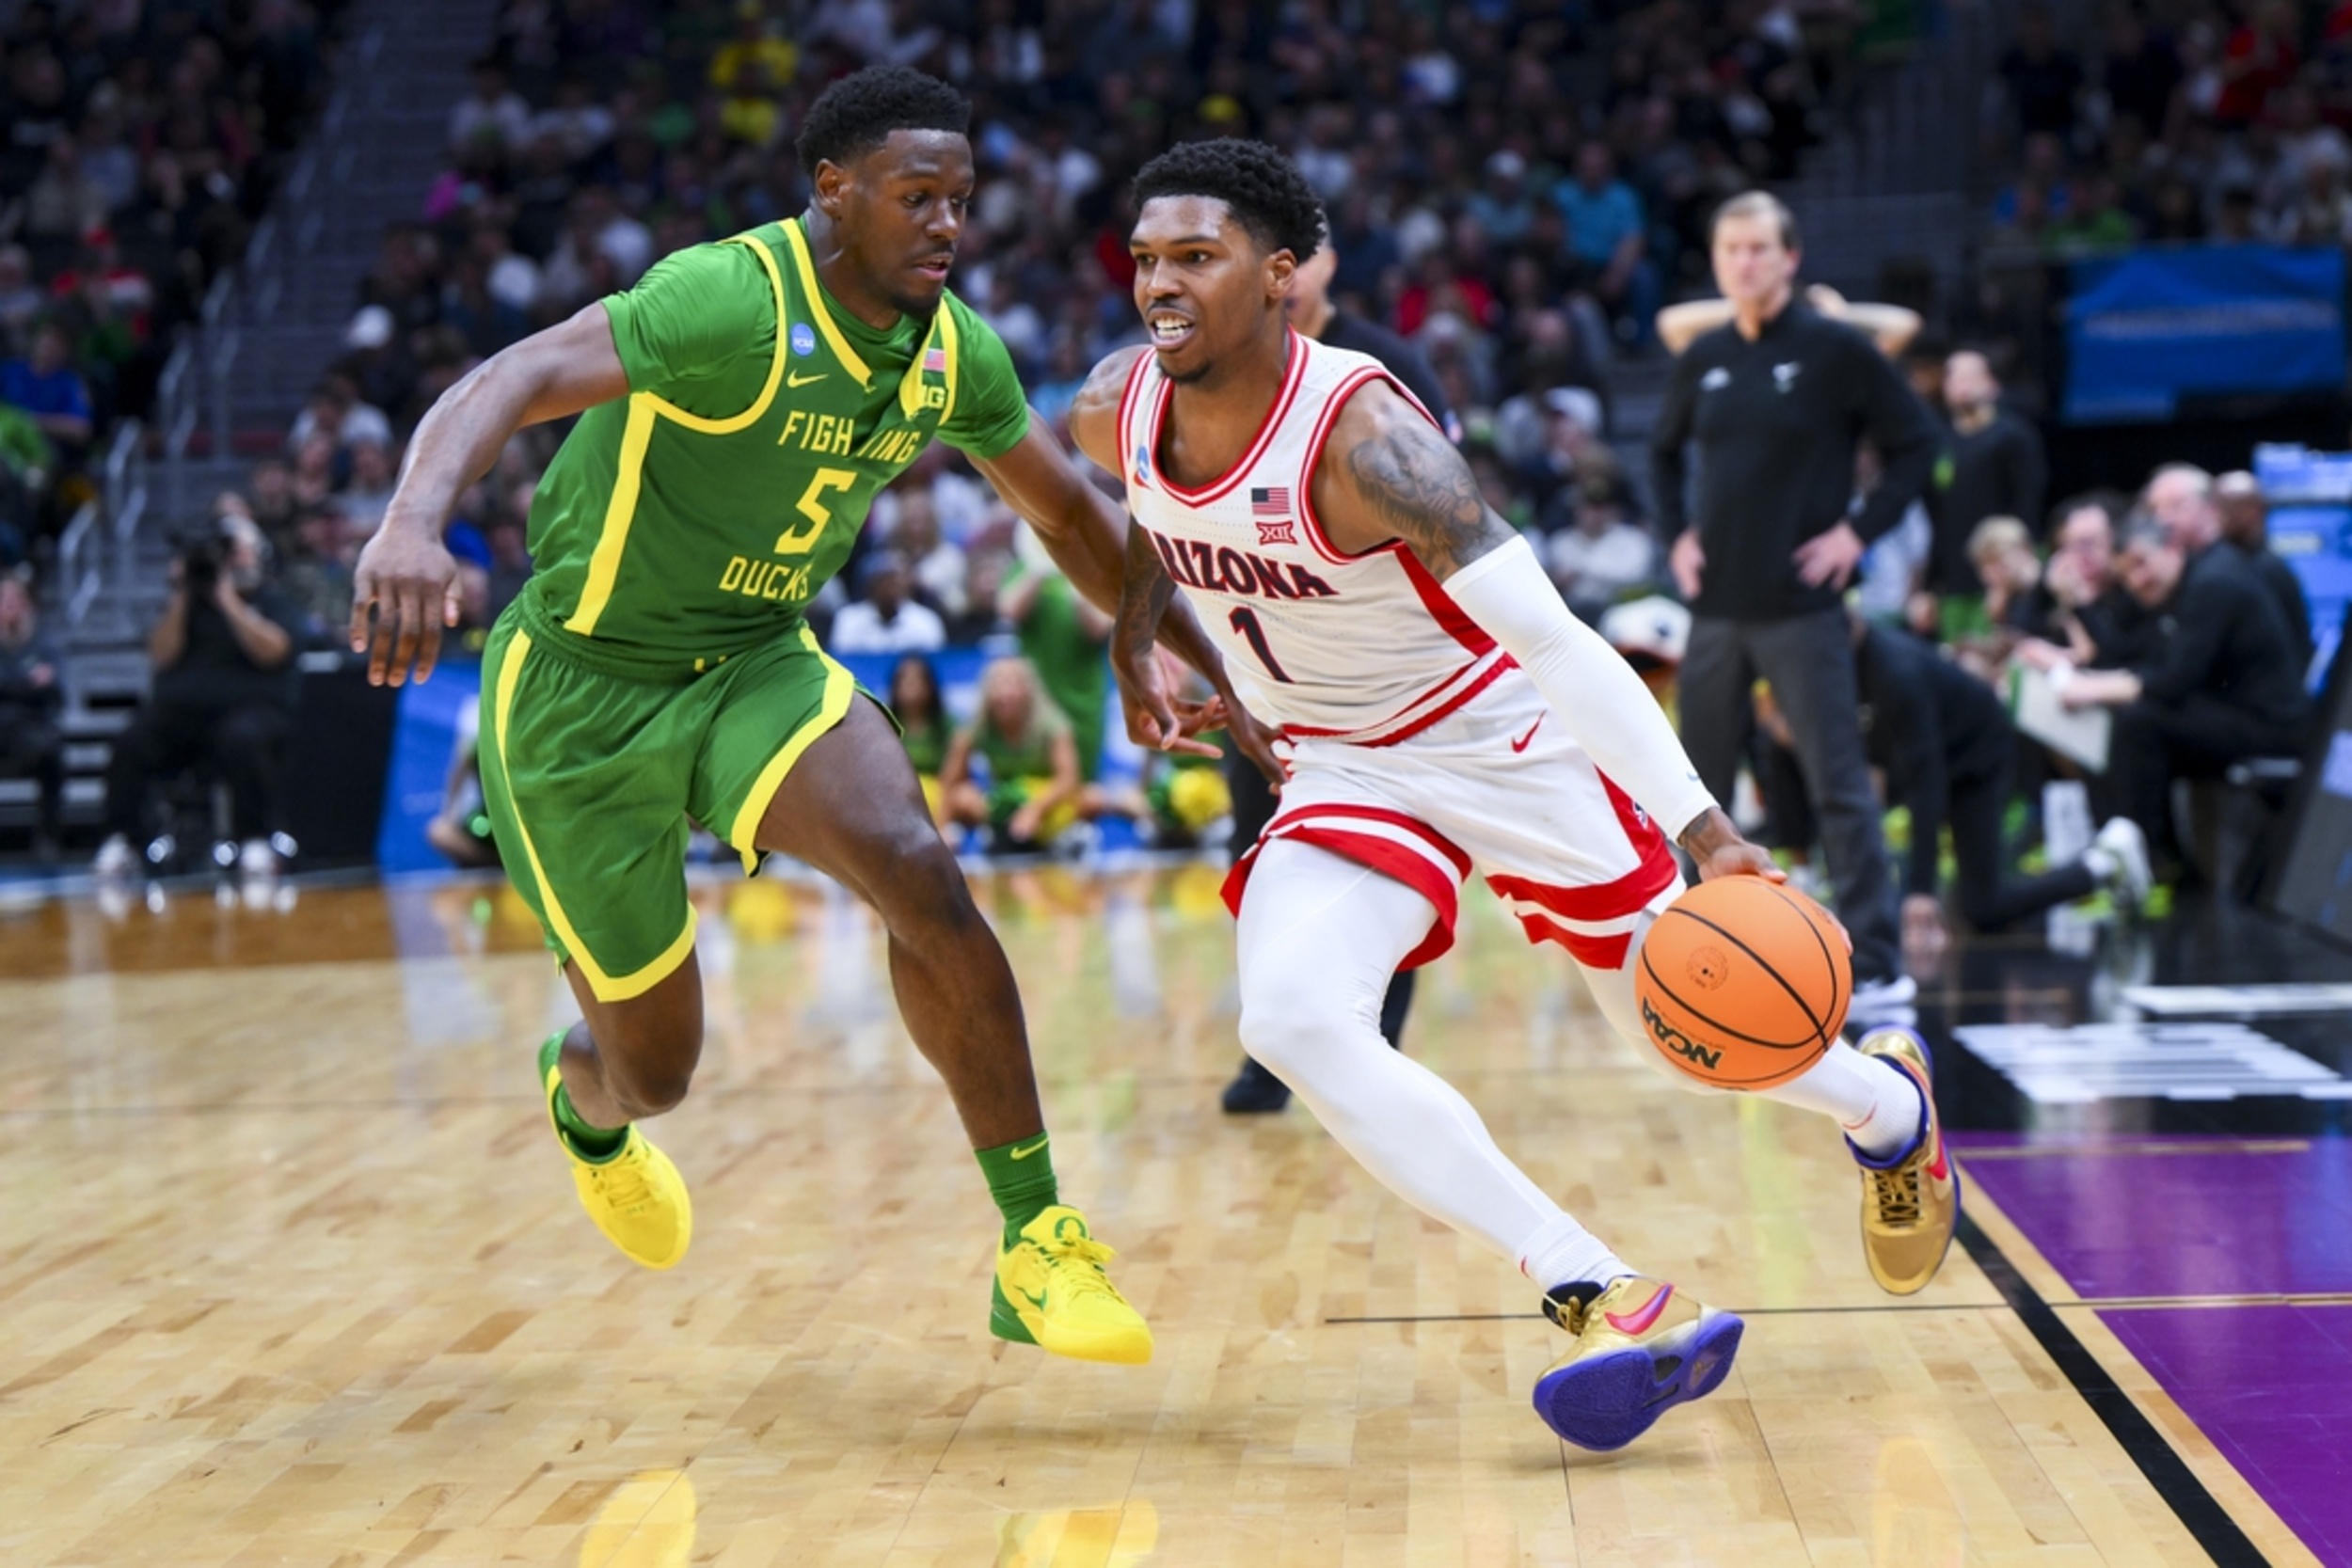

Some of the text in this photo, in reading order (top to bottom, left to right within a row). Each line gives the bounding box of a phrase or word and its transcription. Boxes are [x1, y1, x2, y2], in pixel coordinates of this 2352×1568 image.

[773, 467, 858, 554] 5
[718, 555, 813, 601] DUCKS
[1137, 525, 1341, 600] RIZONA
[1228, 605, 1295, 685] 1
[1642, 996, 1723, 1070] NCAA
